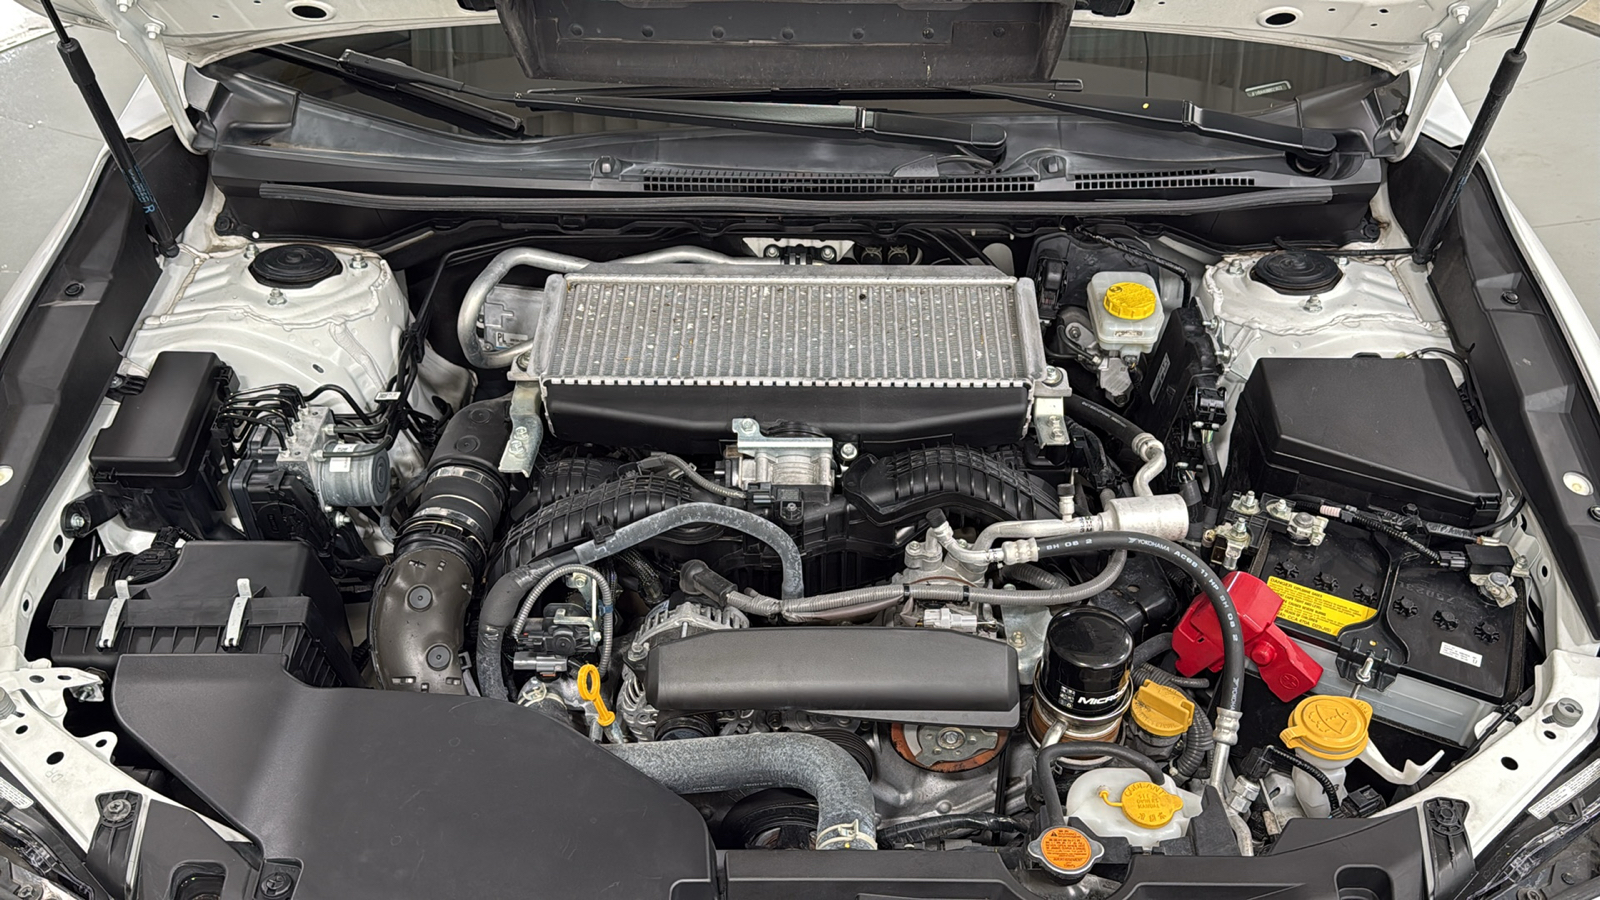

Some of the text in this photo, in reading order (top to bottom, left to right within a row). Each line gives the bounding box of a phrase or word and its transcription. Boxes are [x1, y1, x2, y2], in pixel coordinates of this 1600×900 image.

[143, 204, 155, 213] R
[1137, 538, 1170, 552] YOKOHAMA
[1208, 578, 1220, 591] HP
